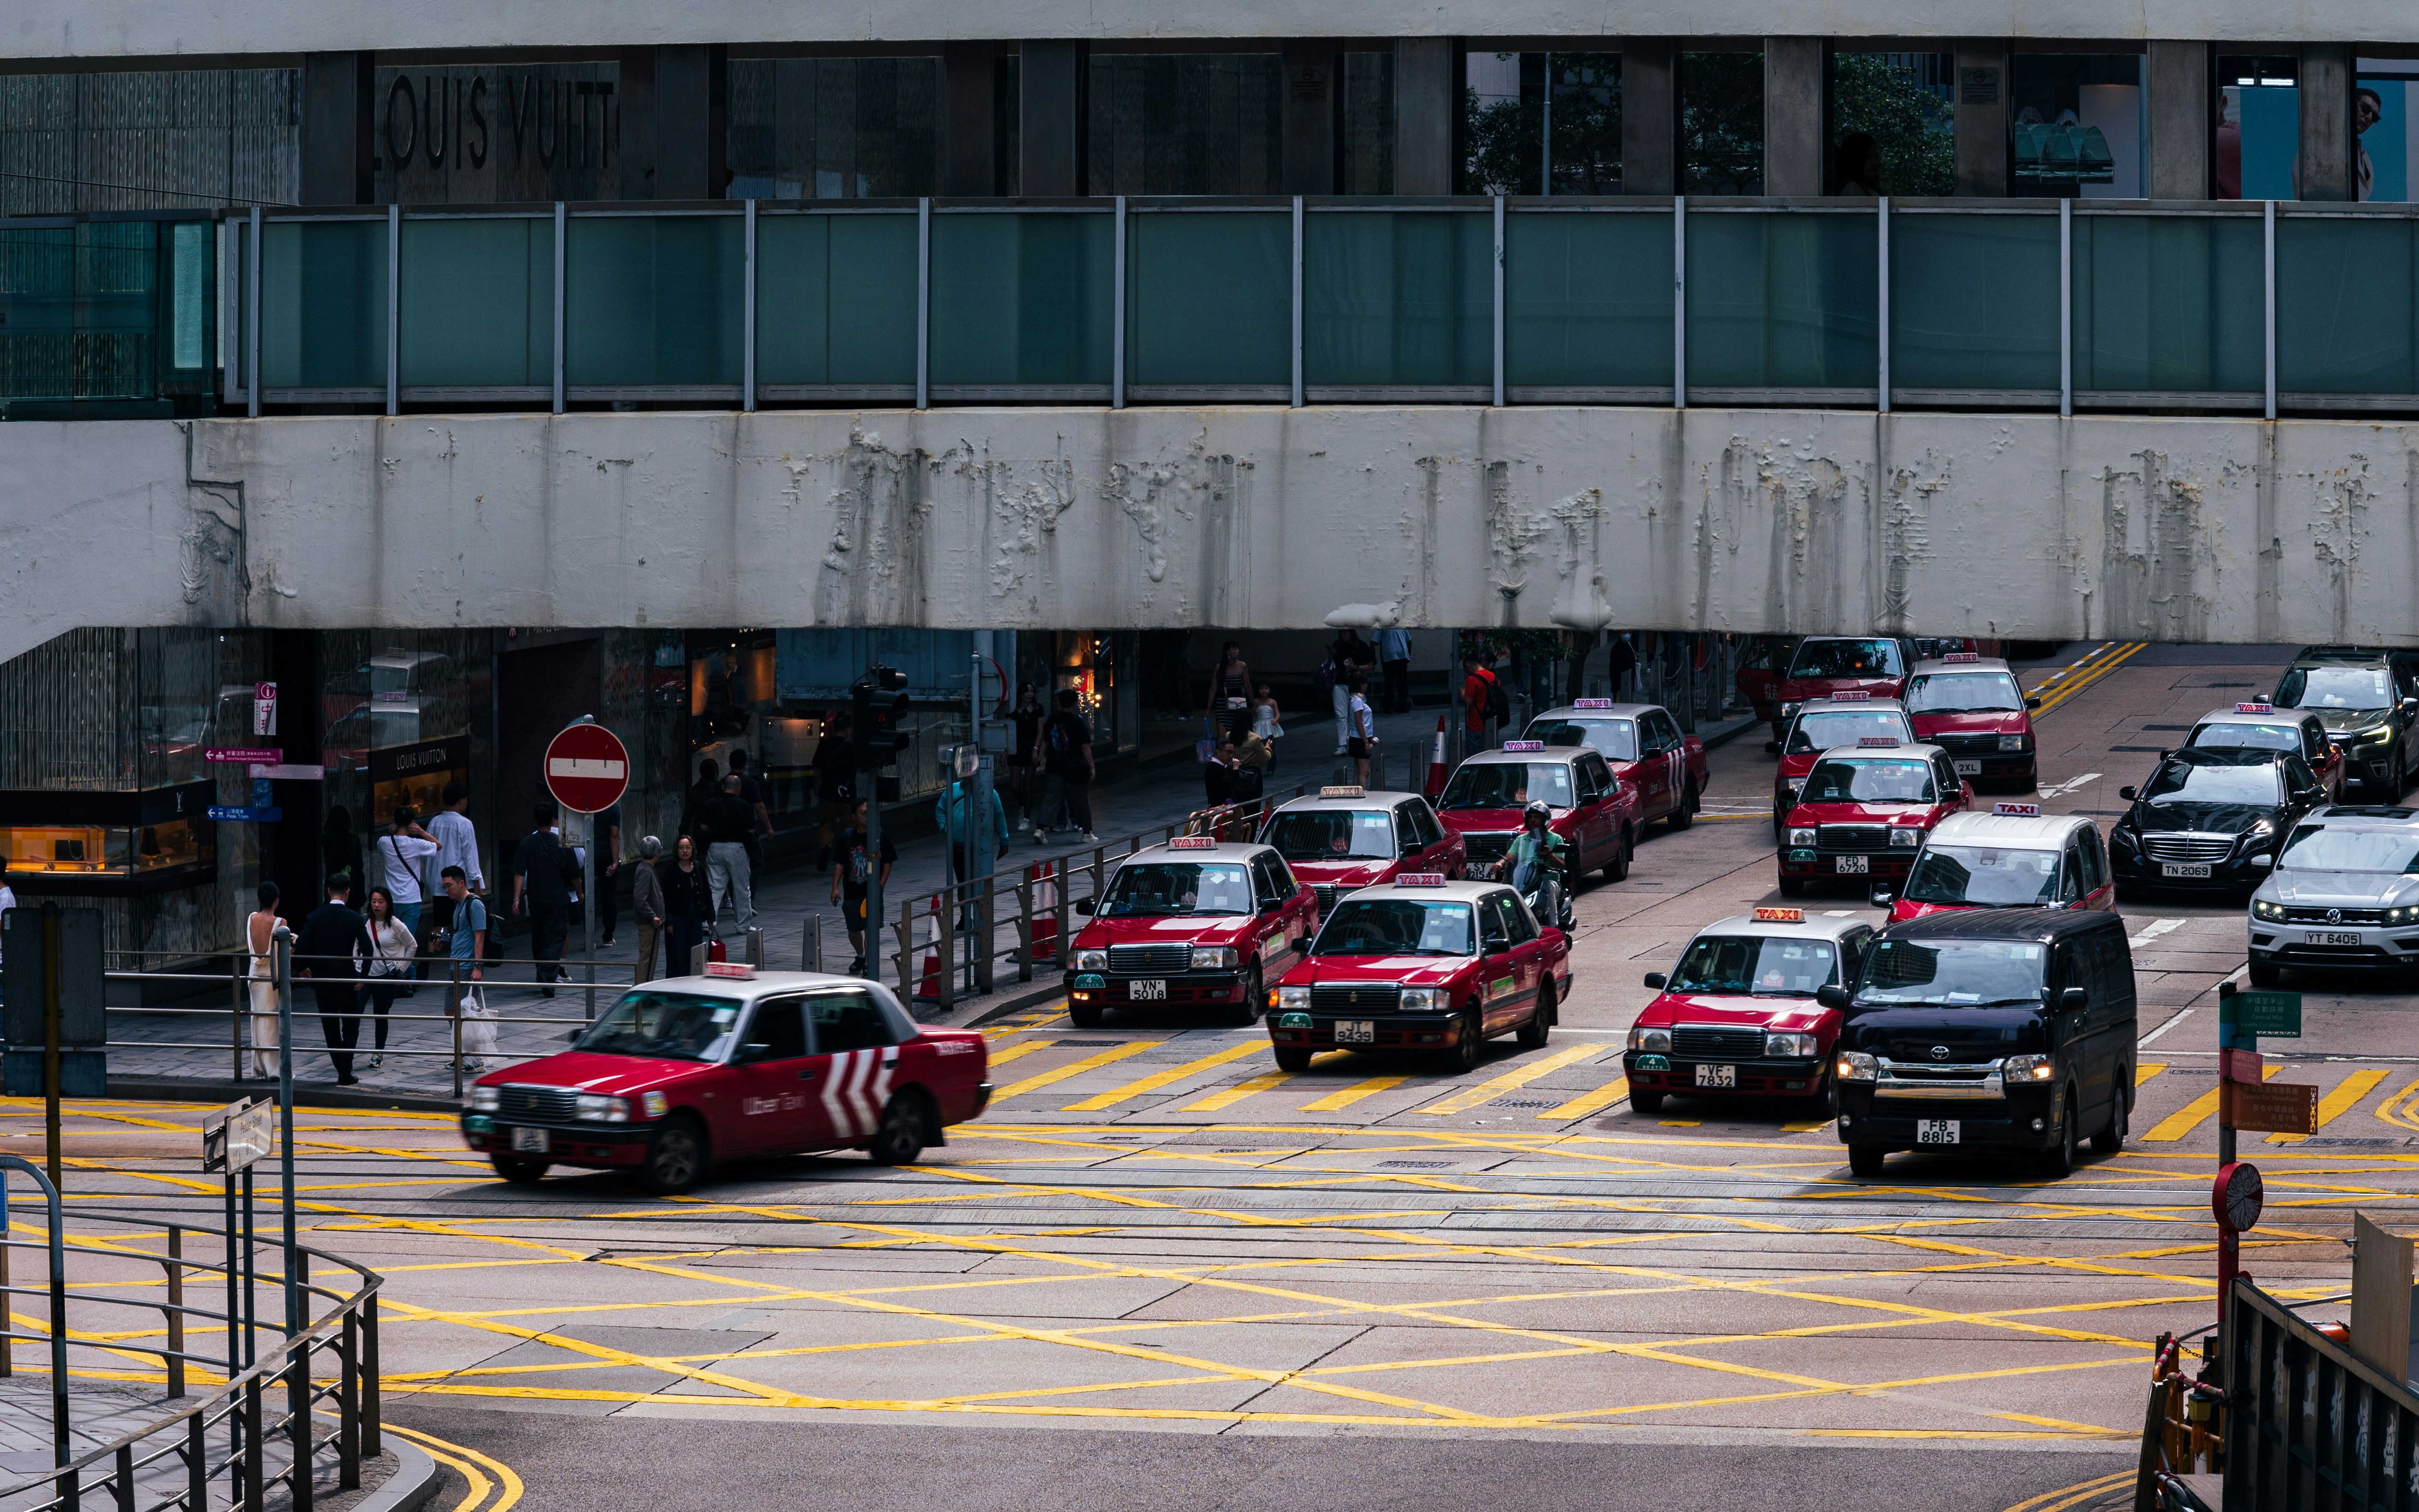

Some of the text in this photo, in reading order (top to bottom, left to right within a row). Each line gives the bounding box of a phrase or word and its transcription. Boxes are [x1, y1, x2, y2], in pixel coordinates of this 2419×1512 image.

[374, 75, 620, 170] OUIS VUITT
[1764, 683, 1777, 691] 的士
[2238, 704, 2270, 712] TAXI
[397, 747, 446, 770] LOUIS VUITTON
[1323, 787, 1359, 796] TAXI
[1649, 782, 1657, 795] Uber
[1998, 804, 2035, 814] TAXI
[1172, 839, 1211, 847] TAXI
[1846, 857, 1859, 865] FD
[1474, 863, 1486, 871] SY
[2165, 865, 2208, 876] TN 2069
[1399, 875, 1440, 884] TAXI
[1470, 870, 1491, 879] 2154
[1757, 909, 1799, 920] TAXI
[2307, 934, 2358, 944] YT 6405
[1142, 981, 1156, 990] VN
[1134, 990, 1164, 999] 5018
[1347, 1022, 1362, 1031] JT
[1338, 1031, 1371, 1041] 9439
[1708, 1065, 1724, 1075] VF
[1698, 1075, 1732, 1086] 7832
[2270, 1114, 2298, 1122] 天星小輪
[241, 1114, 262, 1134] Pedder Street
[1930, 1120, 1948, 1131] FB
[1922, 1131, 1954, 1143] 8815
